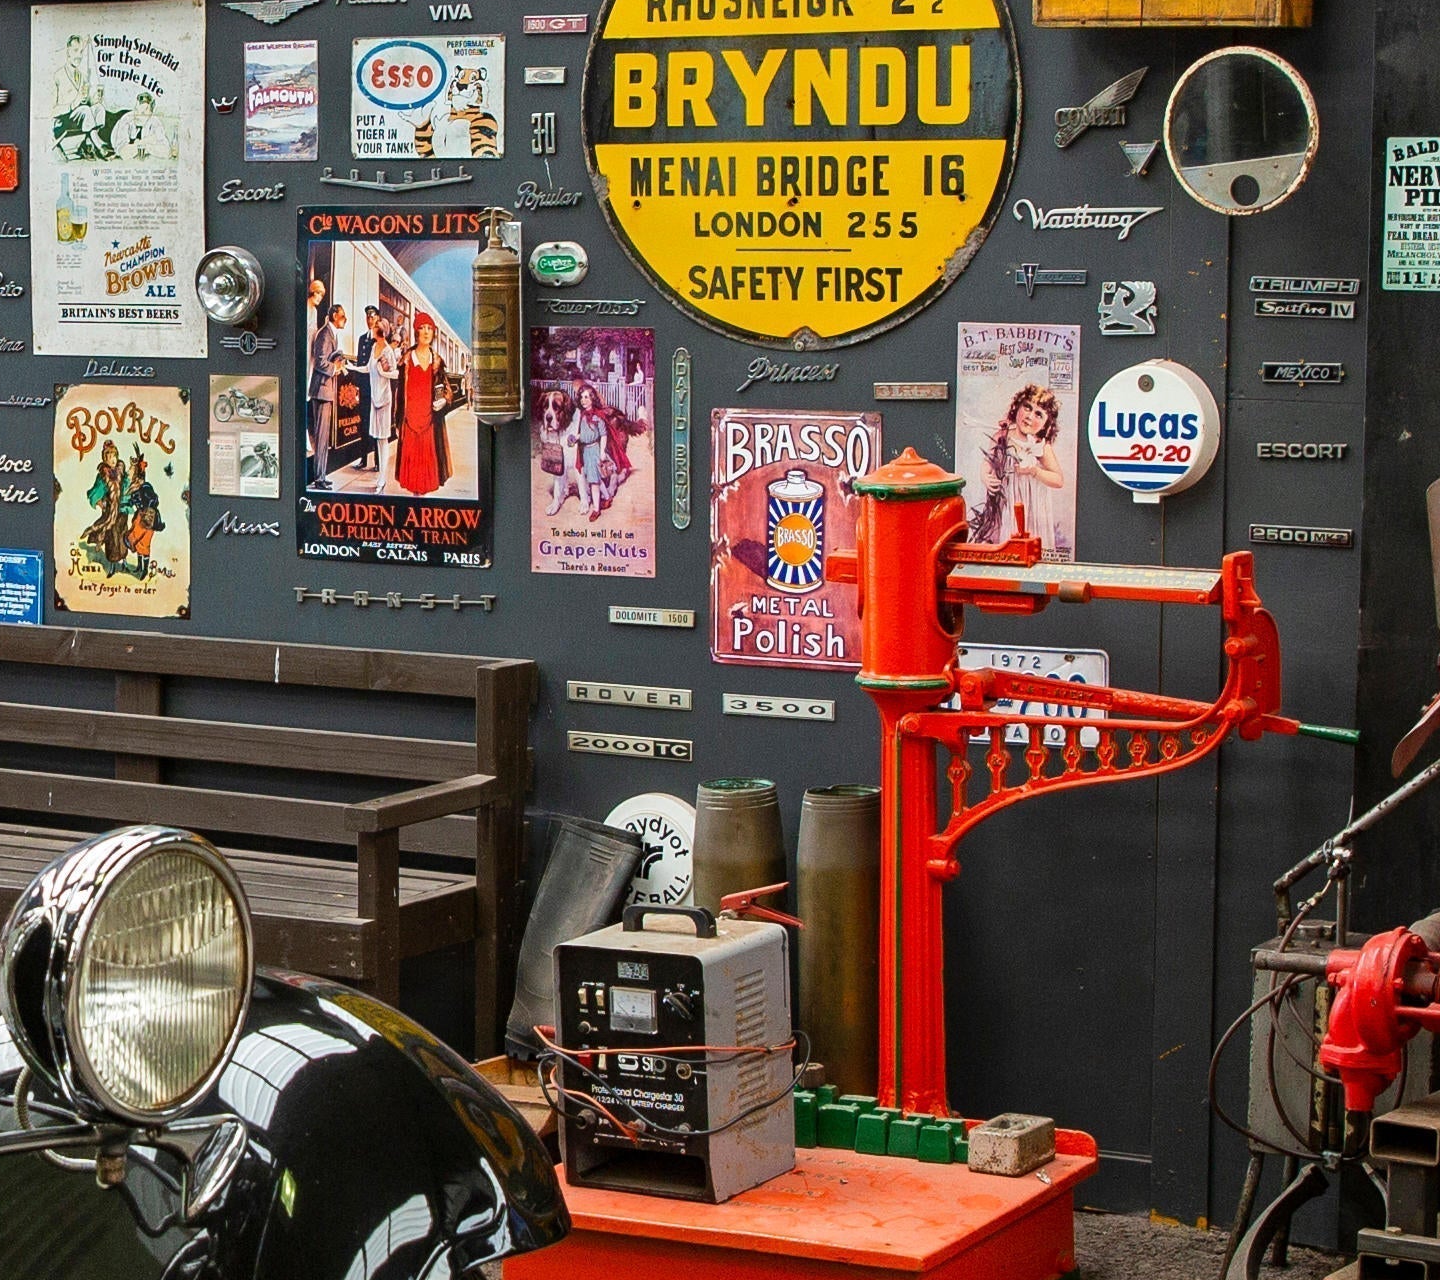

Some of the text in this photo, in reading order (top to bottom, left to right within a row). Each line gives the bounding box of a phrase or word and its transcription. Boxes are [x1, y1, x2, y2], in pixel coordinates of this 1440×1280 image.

[429, 3, 473, 21] VIVA
[93, 34, 179, 72] Simply Splendid
[97, 49, 141, 67] for the
[99, 64, 164, 97] Simple Life
[613, 45, 972, 129] BRYNDU
[248, 84, 314, 112] FALMOUTH
[357, 115, 385, 126] PUT A
[357, 129, 397, 140] TIGER IN
[357, 143, 383, 154] YOUR
[323, 165, 472, 185] CONSUL
[631, 154, 965, 197] MENAI BRIDGE 16
[217, 180, 286, 204] Escort
[333, 212, 479, 235] WAGONS LITS
[694, 211, 918, 239] LONDON 255
[1013, 199, 1165, 241] Wartburg
[104, 235, 152, 268] Newcastle
[120, 245, 165, 273] CHAMPION
[105, 257, 175, 297] Brown
[688, 265, 903, 303] SAFETY FIRST
[1256, 279, 1356, 293] TRIUMPH
[145, 283, 176, 298] ALE
[61, 307, 179, 320] BRITAIN'S BEST BEERS
[736, 355, 840, 392] Princess
[1273, 365, 1331, 381] MEXICO
[66, 401, 177, 461] BOVRIL
[1097, 401, 1199, 440] Lucas
[726, 421, 871, 485] BRASSO
[1129, 443, 1192, 463] 20-20
[1256, 443, 1347, 460] ESCORT
[318, 502, 483, 530] GOLDEN ARROW
[319, 524, 468, 545] ALL PULLMAN TRAIN
[563, 529, 588, 538] school
[590, 529, 606, 538] well
[610, 530, 622, 538] fed
[776, 524, 815, 548] BRASSO
[1251, 527, 1309, 542] 2500
[304, 543, 480, 564] LONDON CALAIS PARIS
[539, 541, 648, 559] Grape-Nuts
[293, 587, 496, 611] TRANSIT
[752, 594, 834, 619] METAL
[616, 611, 688, 624] DOLOMITE 1500
[732, 617, 846, 659] Polish
[575, 687, 683, 706] ROVER
[729, 699, 827, 716] 3500
[571, 736, 688, 758] 2000 TC
